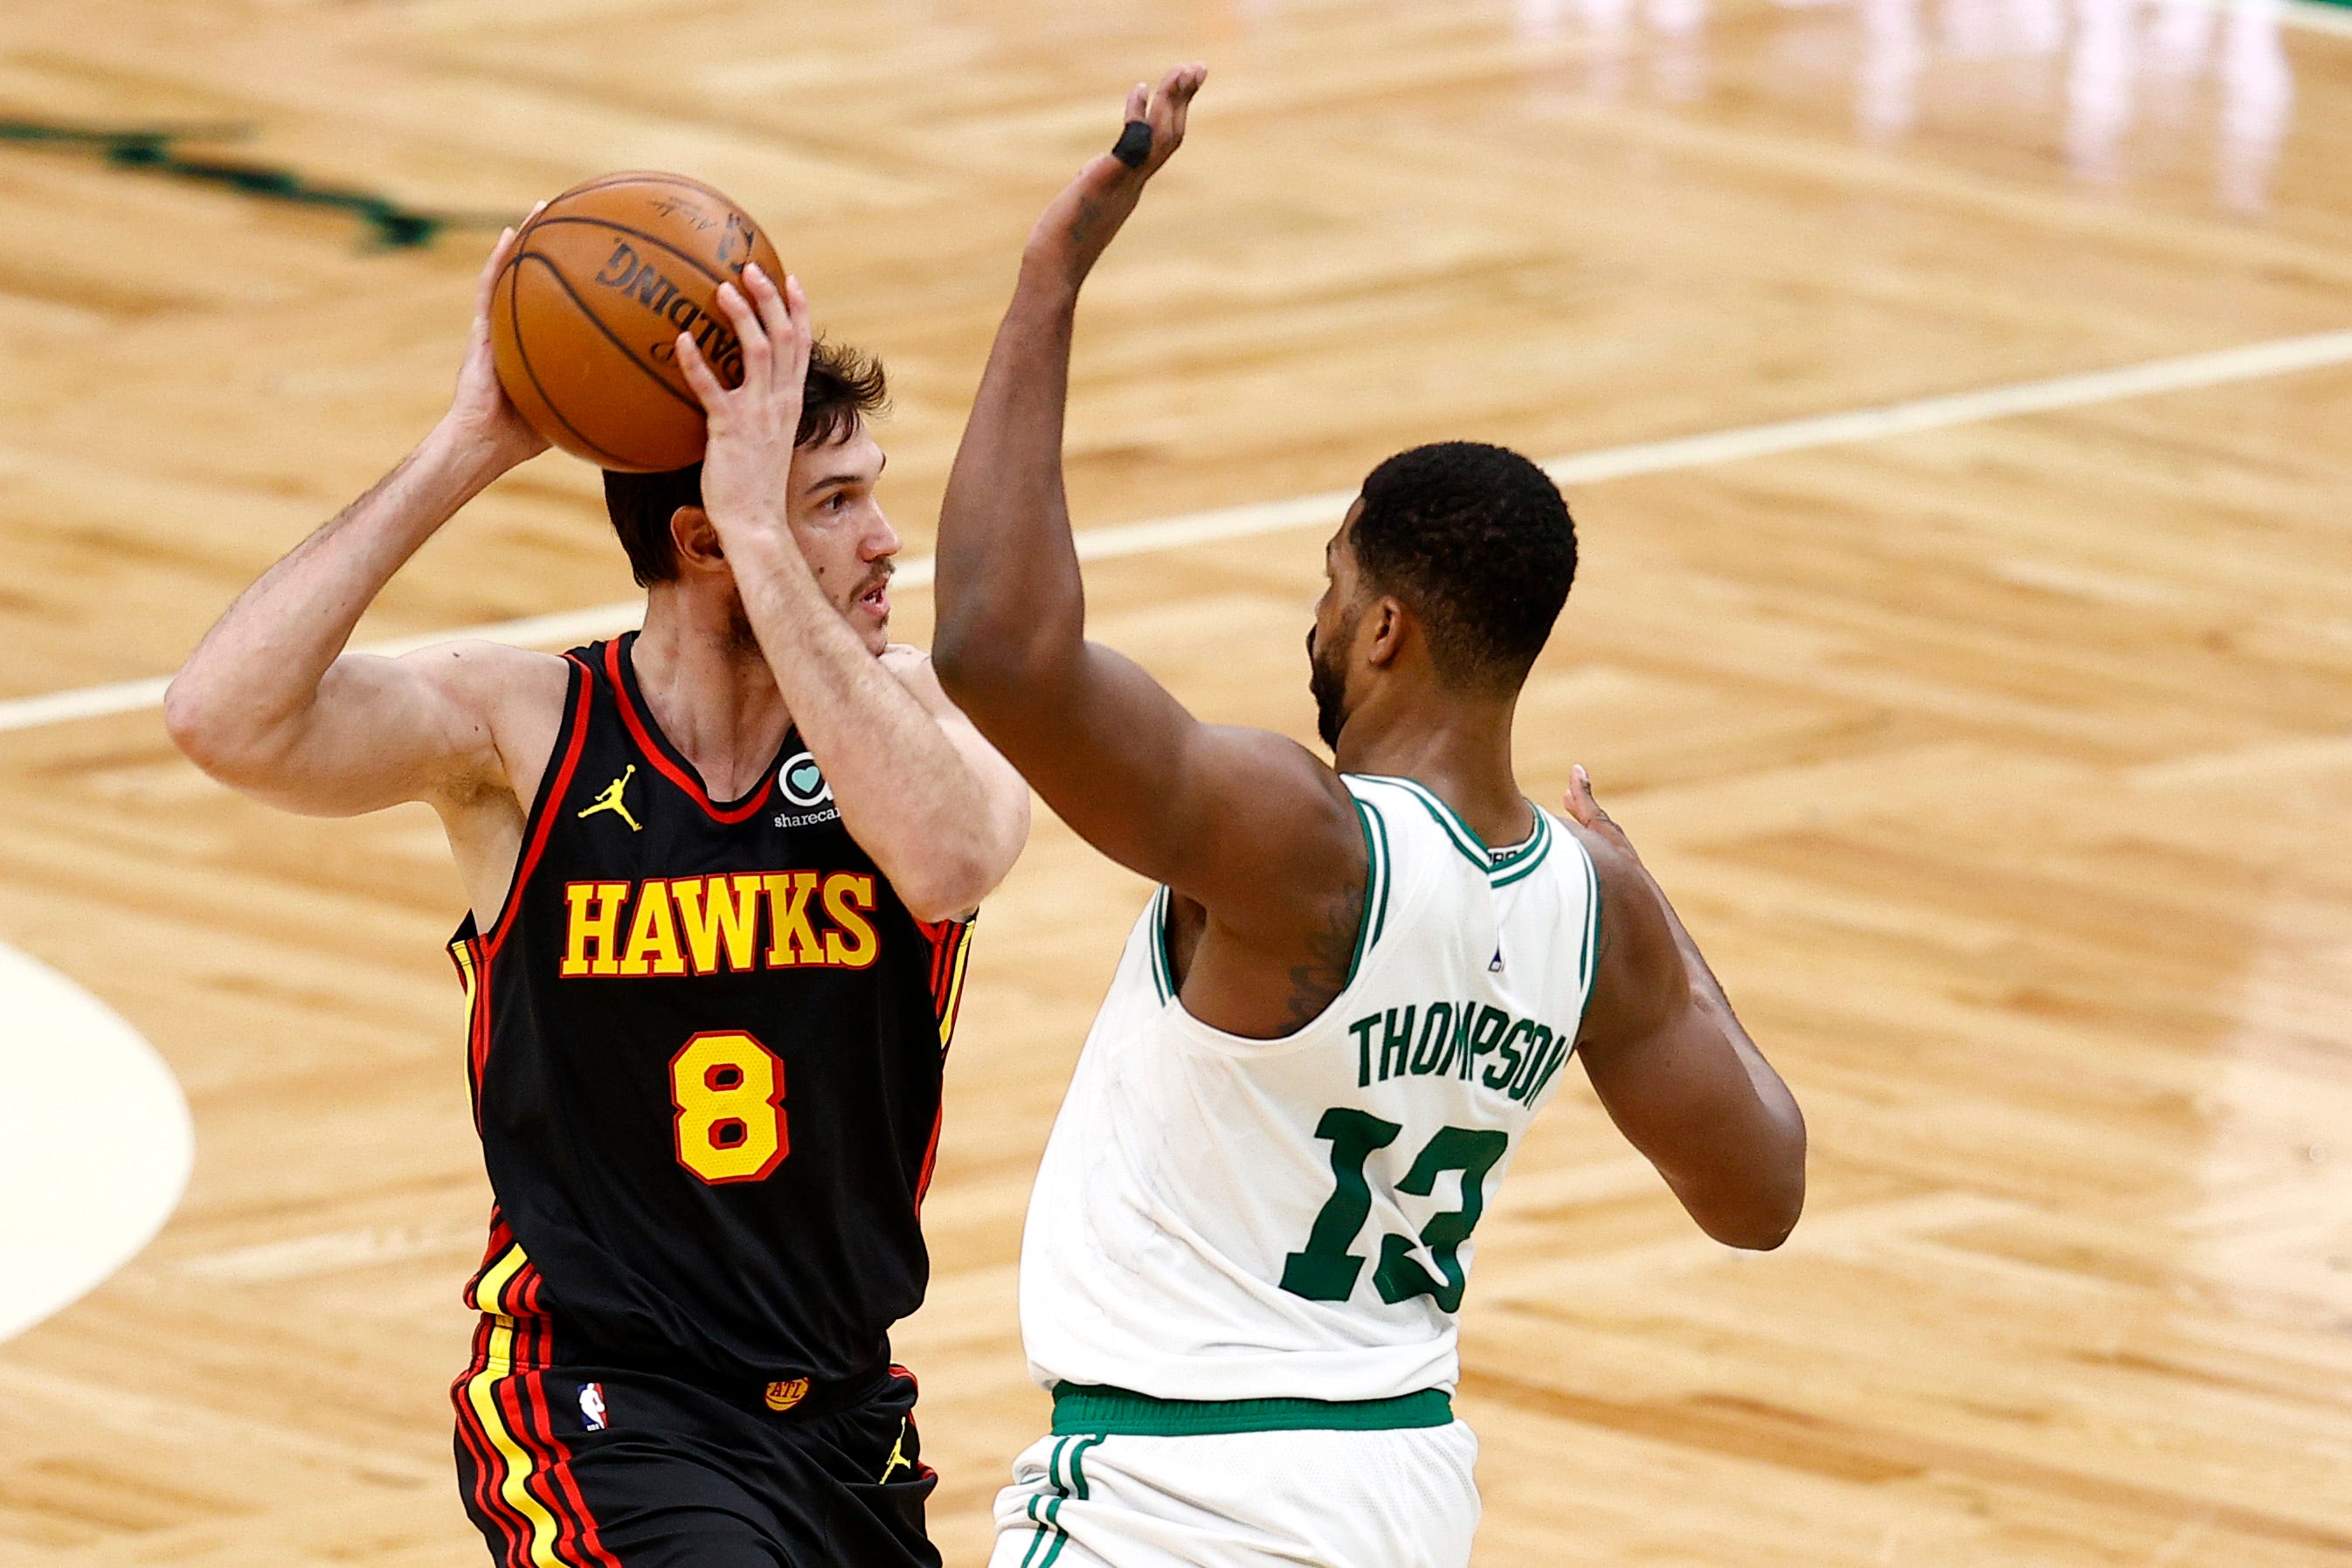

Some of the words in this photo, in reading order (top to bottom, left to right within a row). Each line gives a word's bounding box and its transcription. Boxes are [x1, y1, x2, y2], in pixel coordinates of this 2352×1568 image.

[595, 242, 746, 390] PALDING
[774, 806, 842, 828] sharecar
[559, 869, 881, 978] HAWKS
[668, 1029, 790, 1185] 8
[1278, 1107, 1509, 1314] 13
[769, 1382, 802, 1399] ATL
